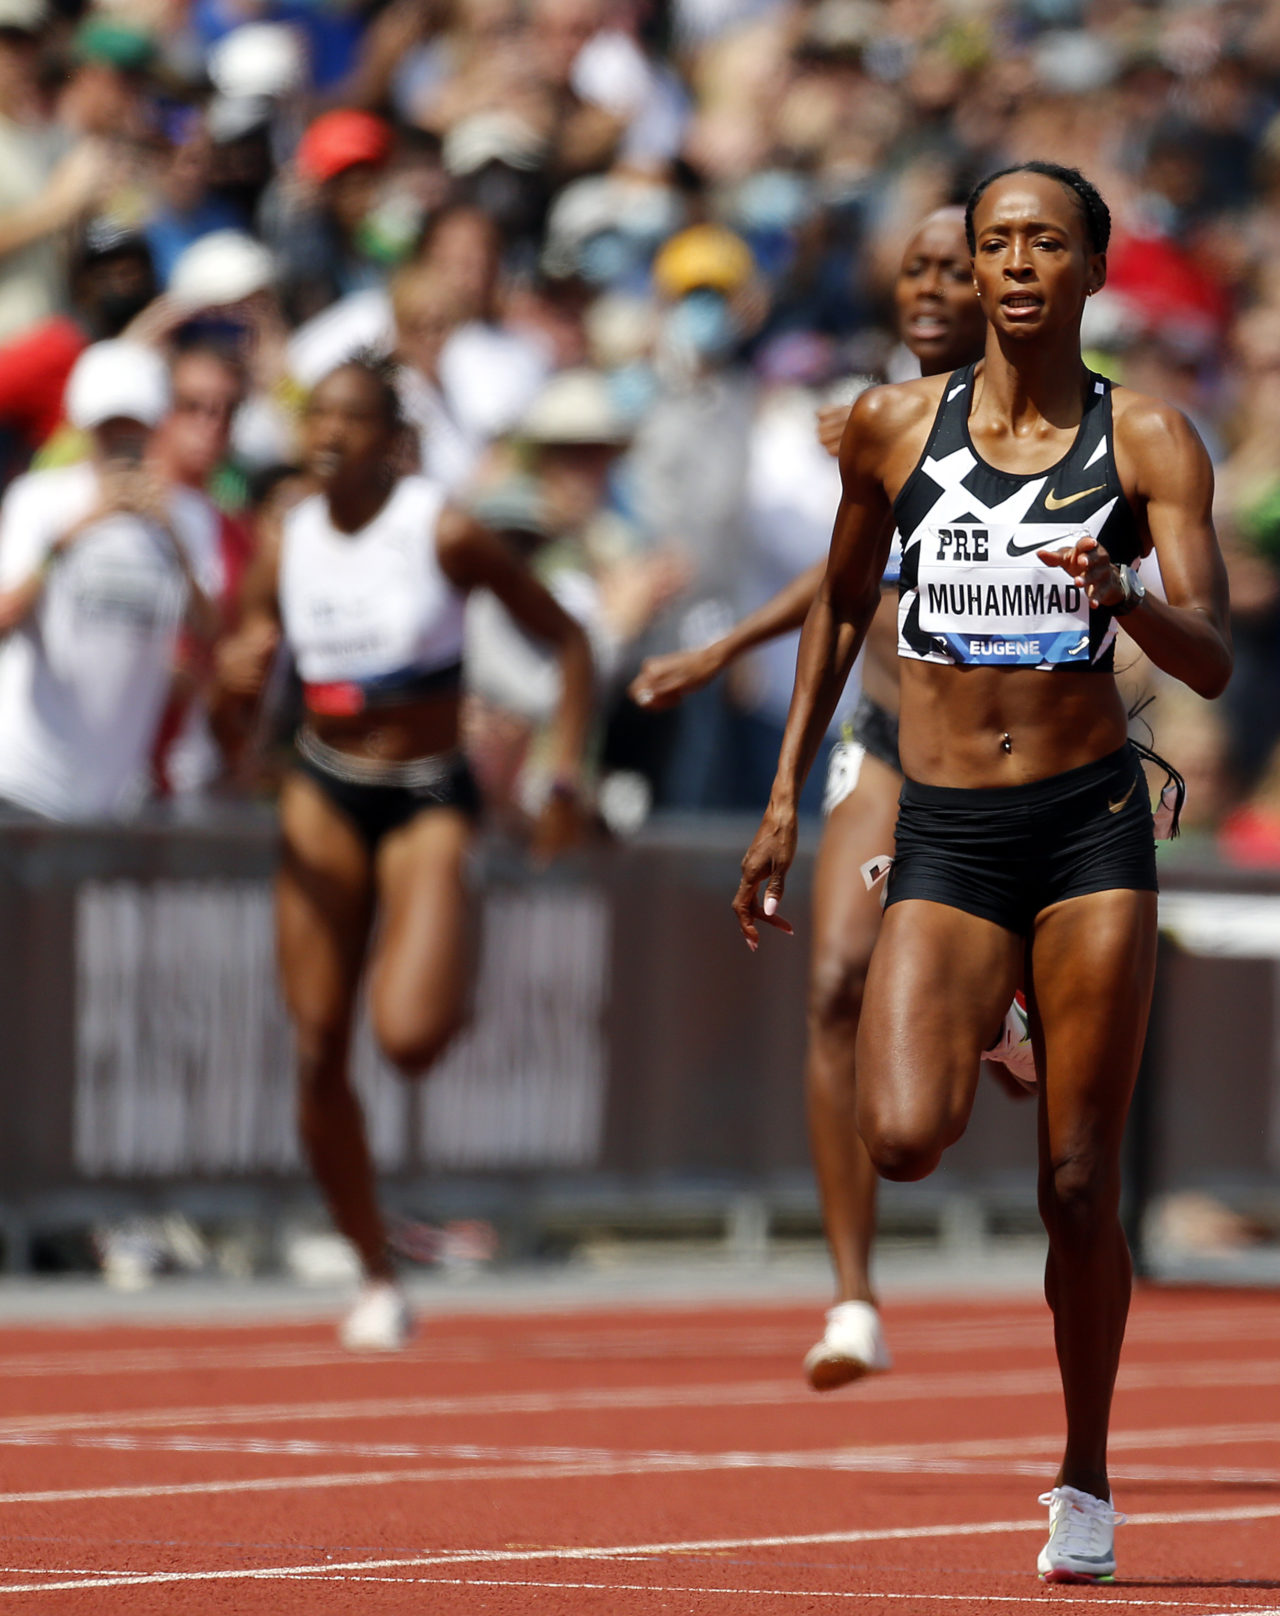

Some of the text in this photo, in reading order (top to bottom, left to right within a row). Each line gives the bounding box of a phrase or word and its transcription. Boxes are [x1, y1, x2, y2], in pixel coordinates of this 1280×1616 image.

[936, 529, 989, 561] PRE
[927, 583, 1081, 616] MUHAMMAD
[969, 640, 1040, 656] EUGENE
